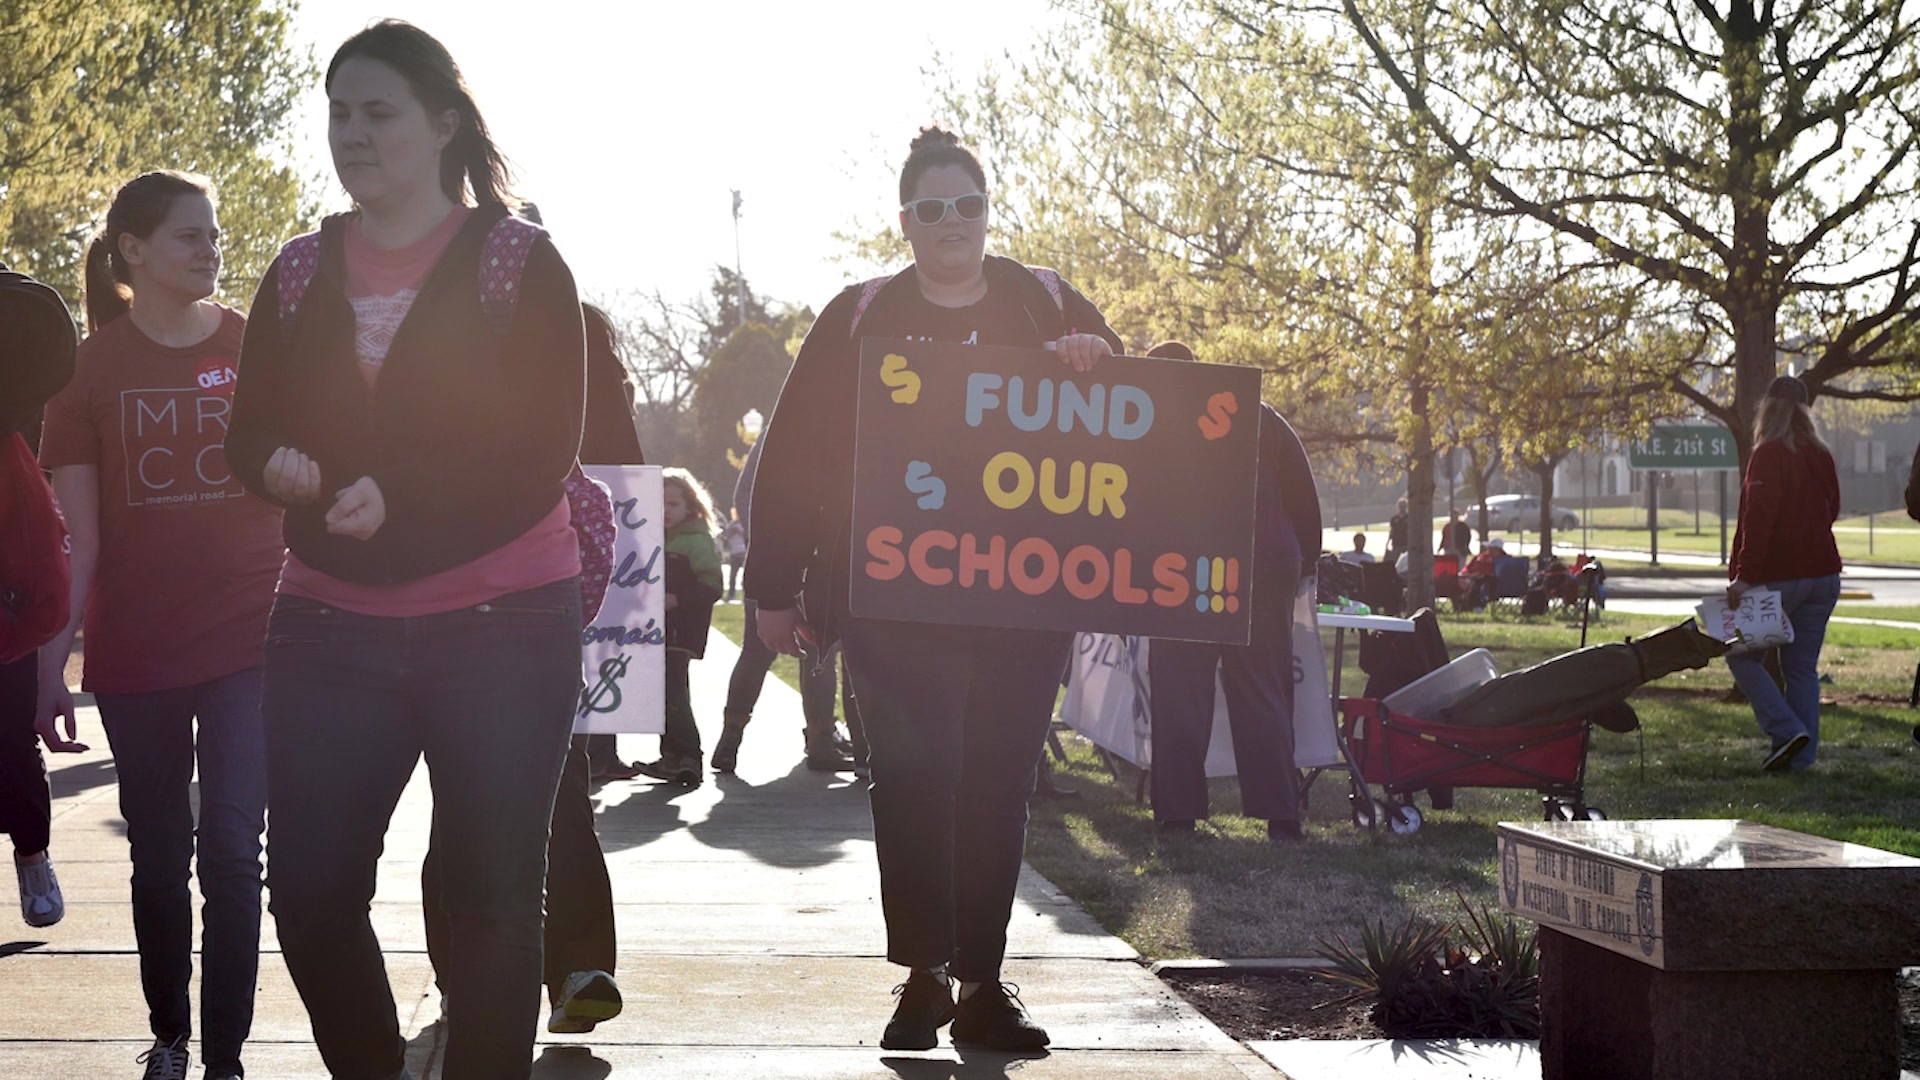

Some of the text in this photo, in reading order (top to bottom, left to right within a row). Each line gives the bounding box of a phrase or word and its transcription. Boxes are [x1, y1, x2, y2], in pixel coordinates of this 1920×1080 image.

[197, 366, 238, 389] OEA
[965, 372, 1155, 441] FUND
[1636, 437, 1727, 456] N.E. 21st St
[146, 490, 225, 504] memorial road
[983, 451, 1129, 519] OUR
[865, 526, 1240, 614] SCHOOLS!!!
[1760, 594, 1777, 623] WE
[1536, 846, 1615, 896] STATE OF OKLAHOMA
